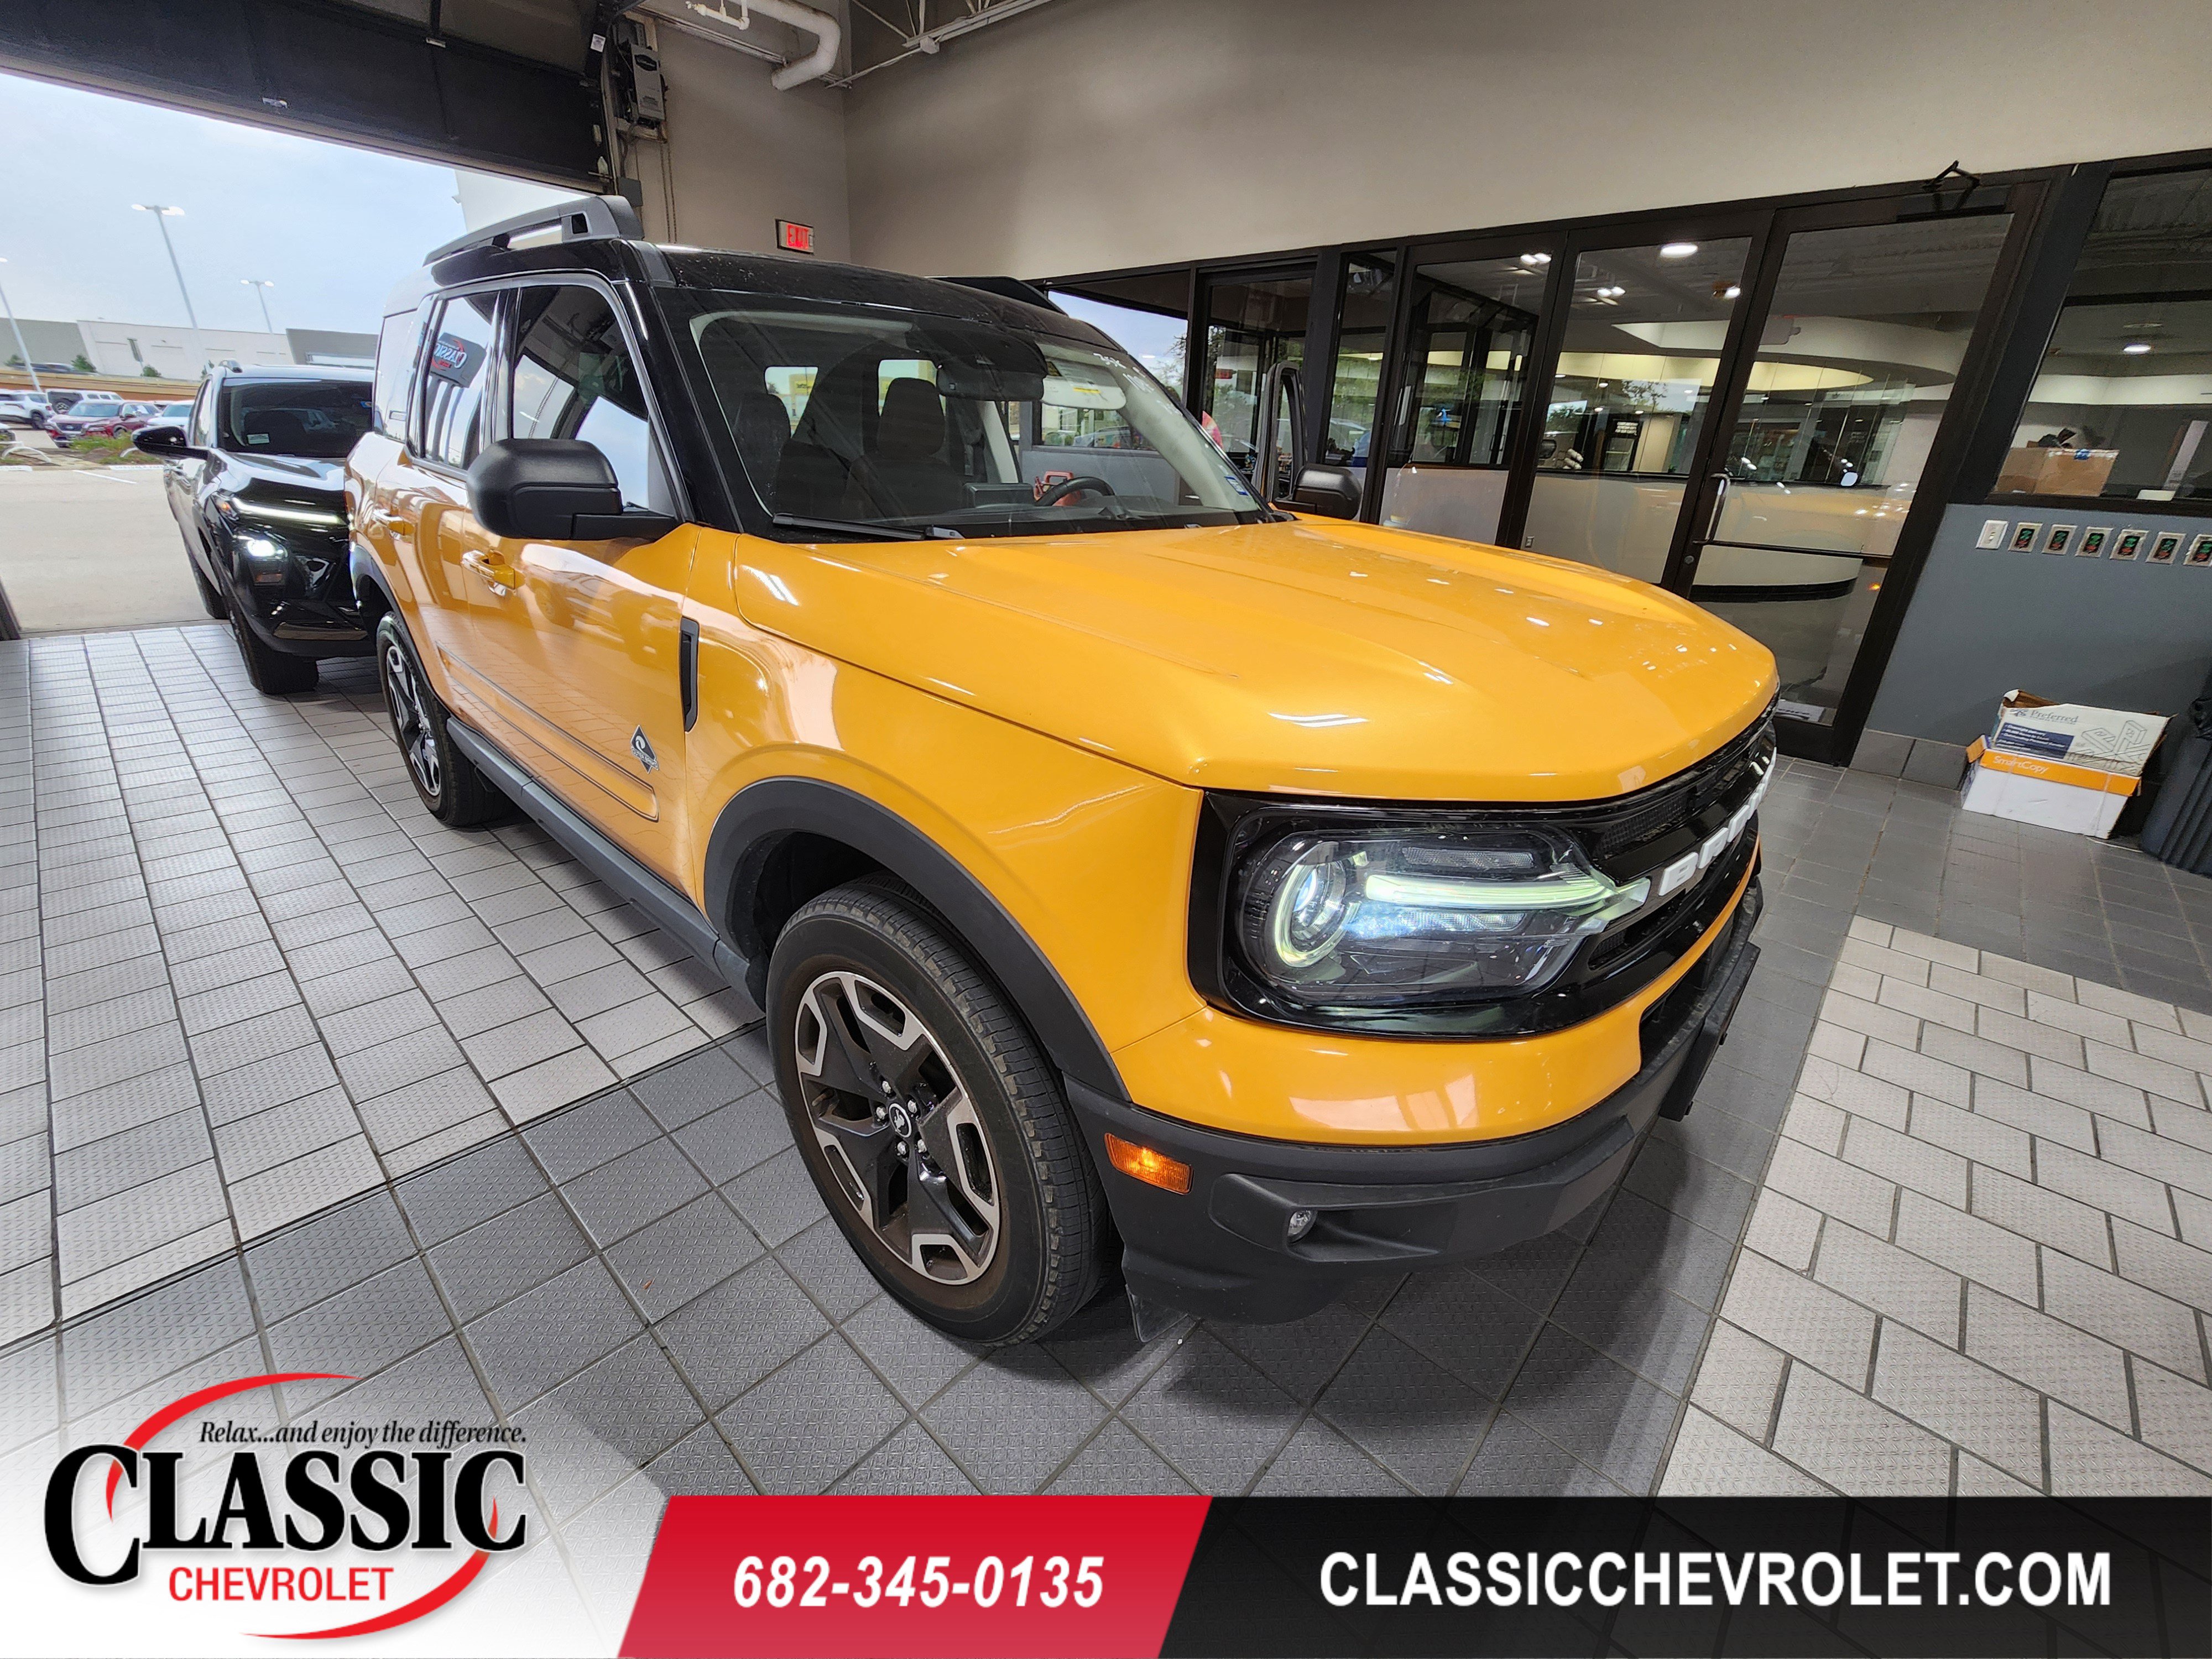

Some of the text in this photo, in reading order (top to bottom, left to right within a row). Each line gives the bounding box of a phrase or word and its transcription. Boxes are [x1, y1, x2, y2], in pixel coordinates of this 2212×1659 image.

[787, 224, 809, 250] EXIT
[2031, 710, 2079, 723] Preferred
[1993, 755, 2049, 774] SmartCopy
